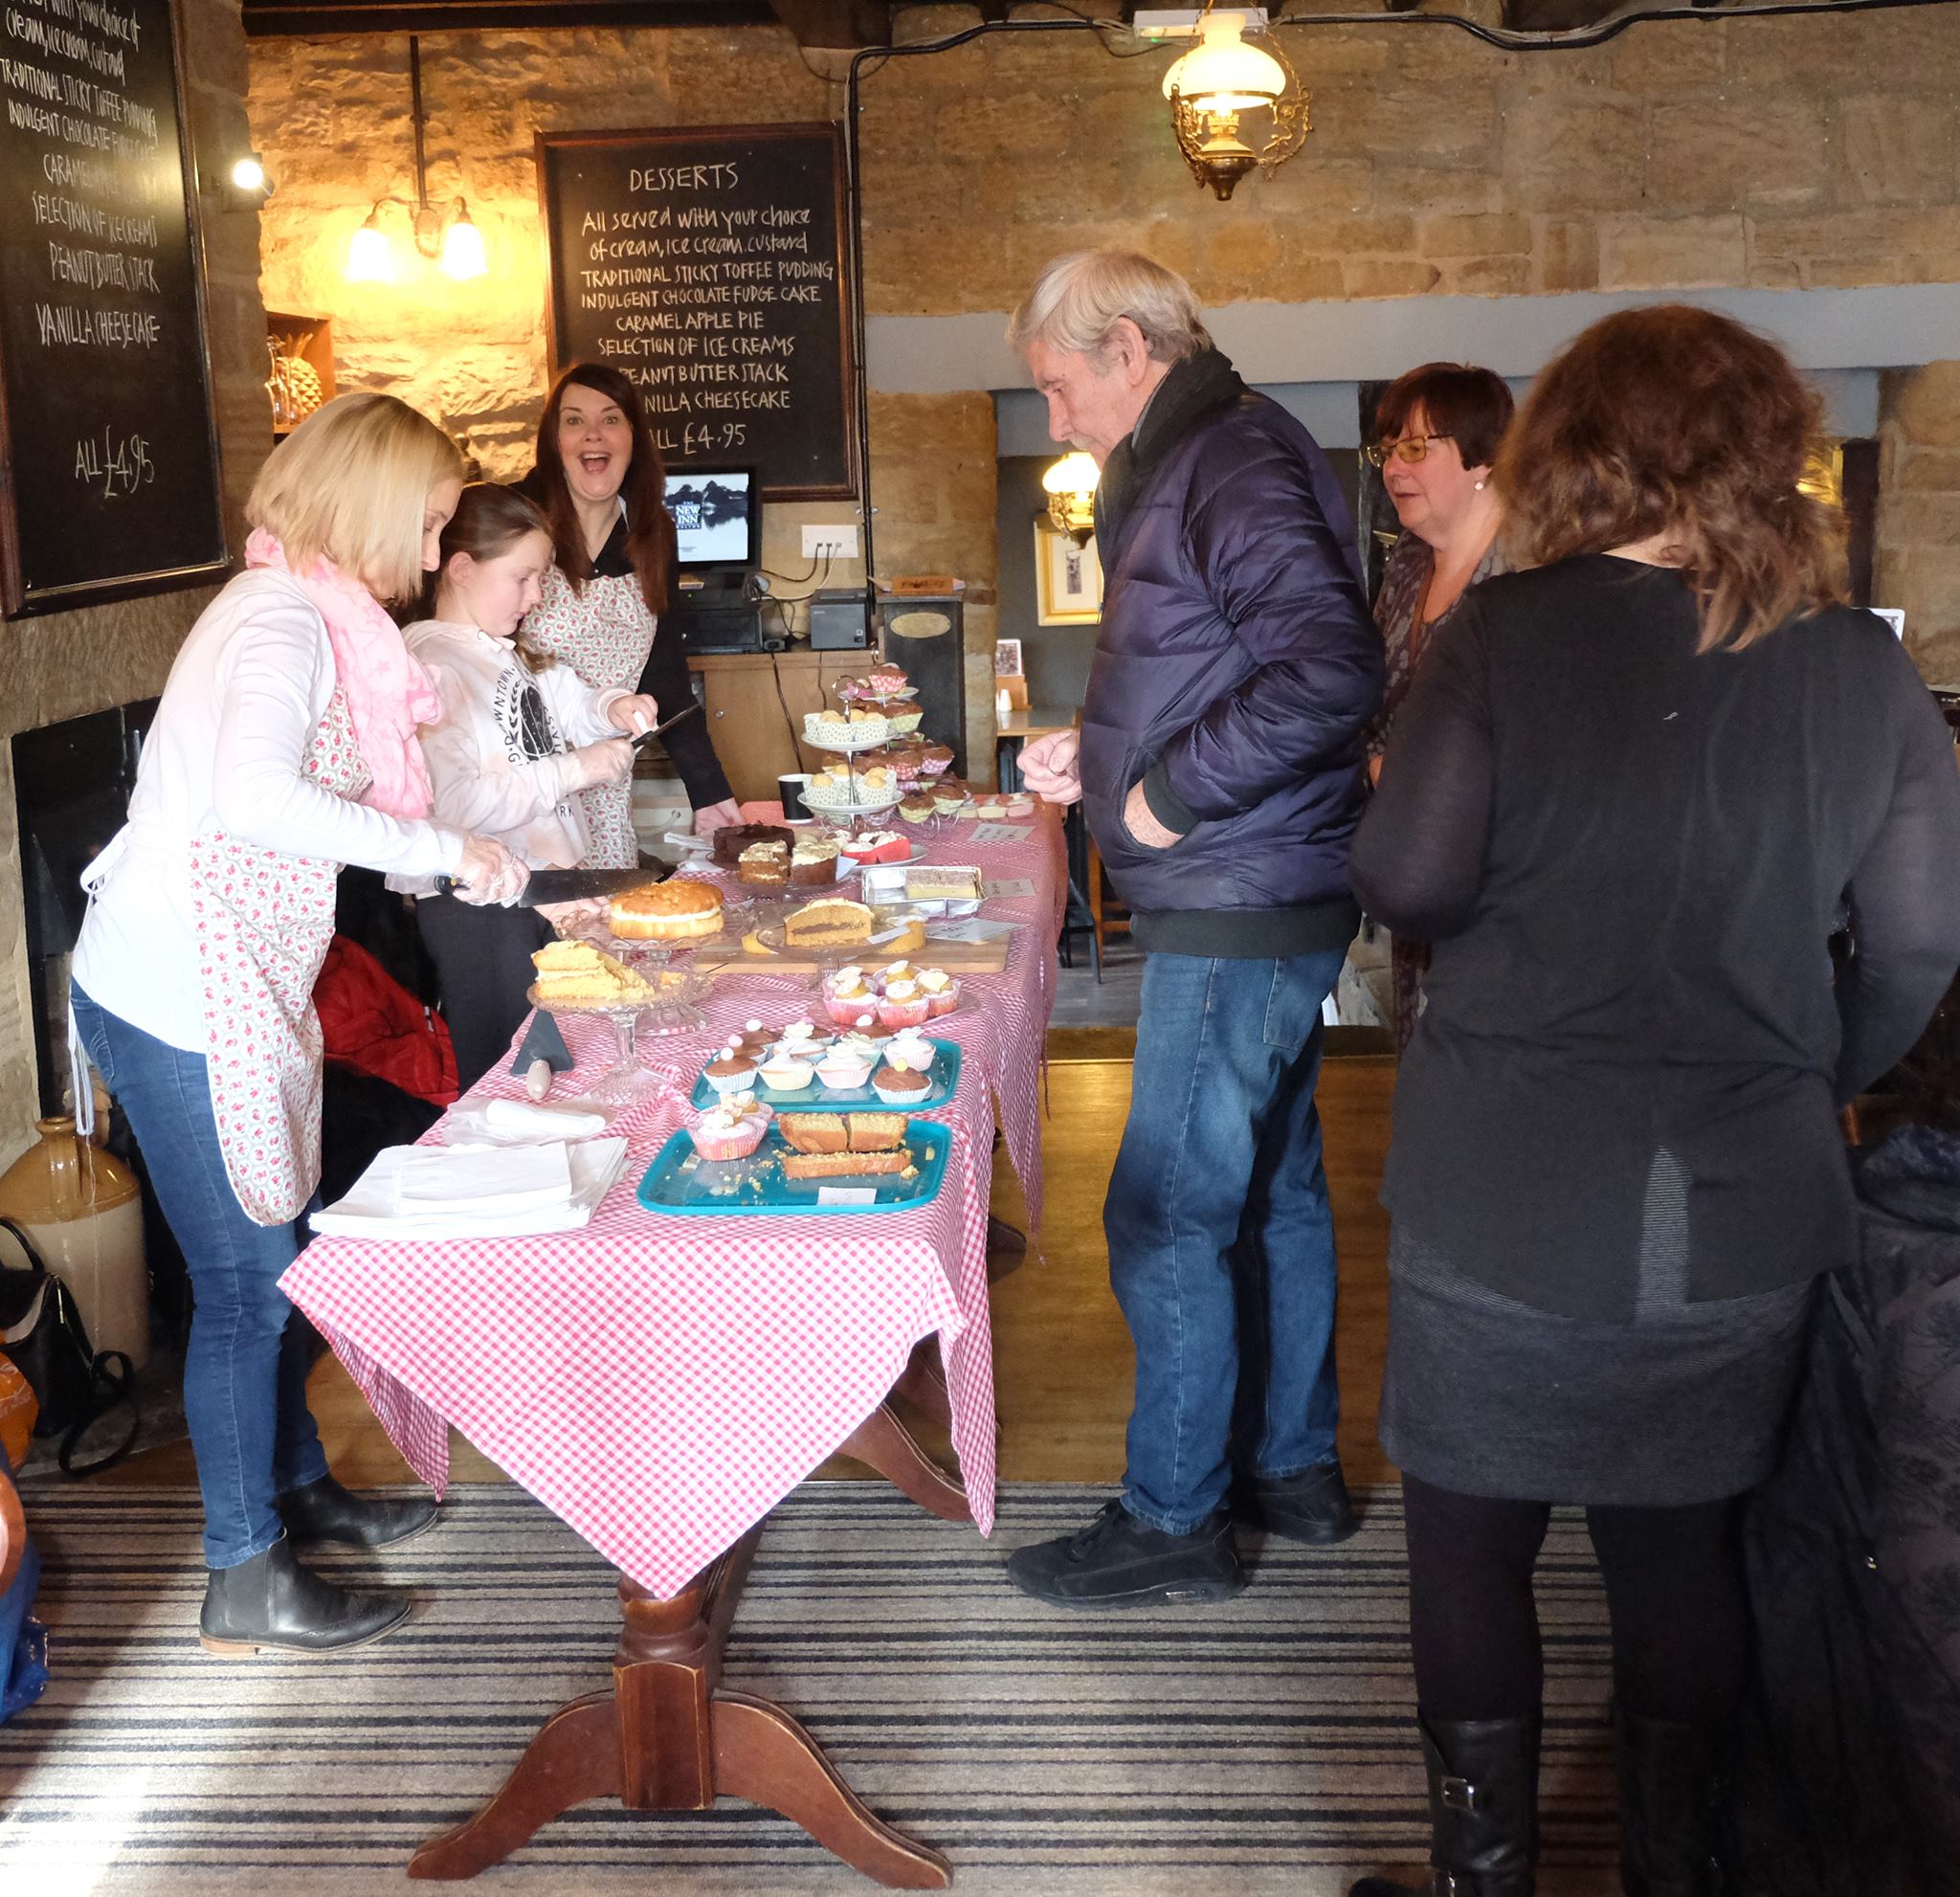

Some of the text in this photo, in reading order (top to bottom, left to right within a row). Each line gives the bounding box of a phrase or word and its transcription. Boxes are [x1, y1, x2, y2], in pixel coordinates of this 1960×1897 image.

[100, 0, 131, 41] choice
[0, 58, 64, 101] TRADITIONAL
[61, 74, 91, 113] STICKY
[92, 84, 122, 123] TOFFEE
[8, 98, 59, 136] INDULGENT
[61, 115, 110, 151] CHOCOLATE
[629, 162, 739, 192] DESSERTS
[33, 190, 93, 234] SELECTION
[580, 204, 811, 237] All served with your choice
[590, 237, 609, 262] of
[747, 231, 808, 254] custard
[49, 240, 161, 294] PEANUT BUTTER STACK
[580, 259, 834, 288] TRADITIONAL STICKY TOFFEE PUDDING
[581, 283, 822, 312] INDULGENT CHOCOLATE FUDGE CAKE
[34, 302, 96, 347] VANILLA
[615, 309, 766, 334] CARAMEL APPLE PIE
[597, 335, 796, 358] SELECTION OF ICE CREAMS
[678, 362, 741, 384] BUTTER
[741, 362, 790, 383] STACK
[644, 390, 791, 414] NILLA CHEESECAKE
[683, 421, 746, 456] £4.95
[75, 439, 102, 483] ALL
[676, 504, 701, 516] NEW
[677, 515, 699, 525] INN
